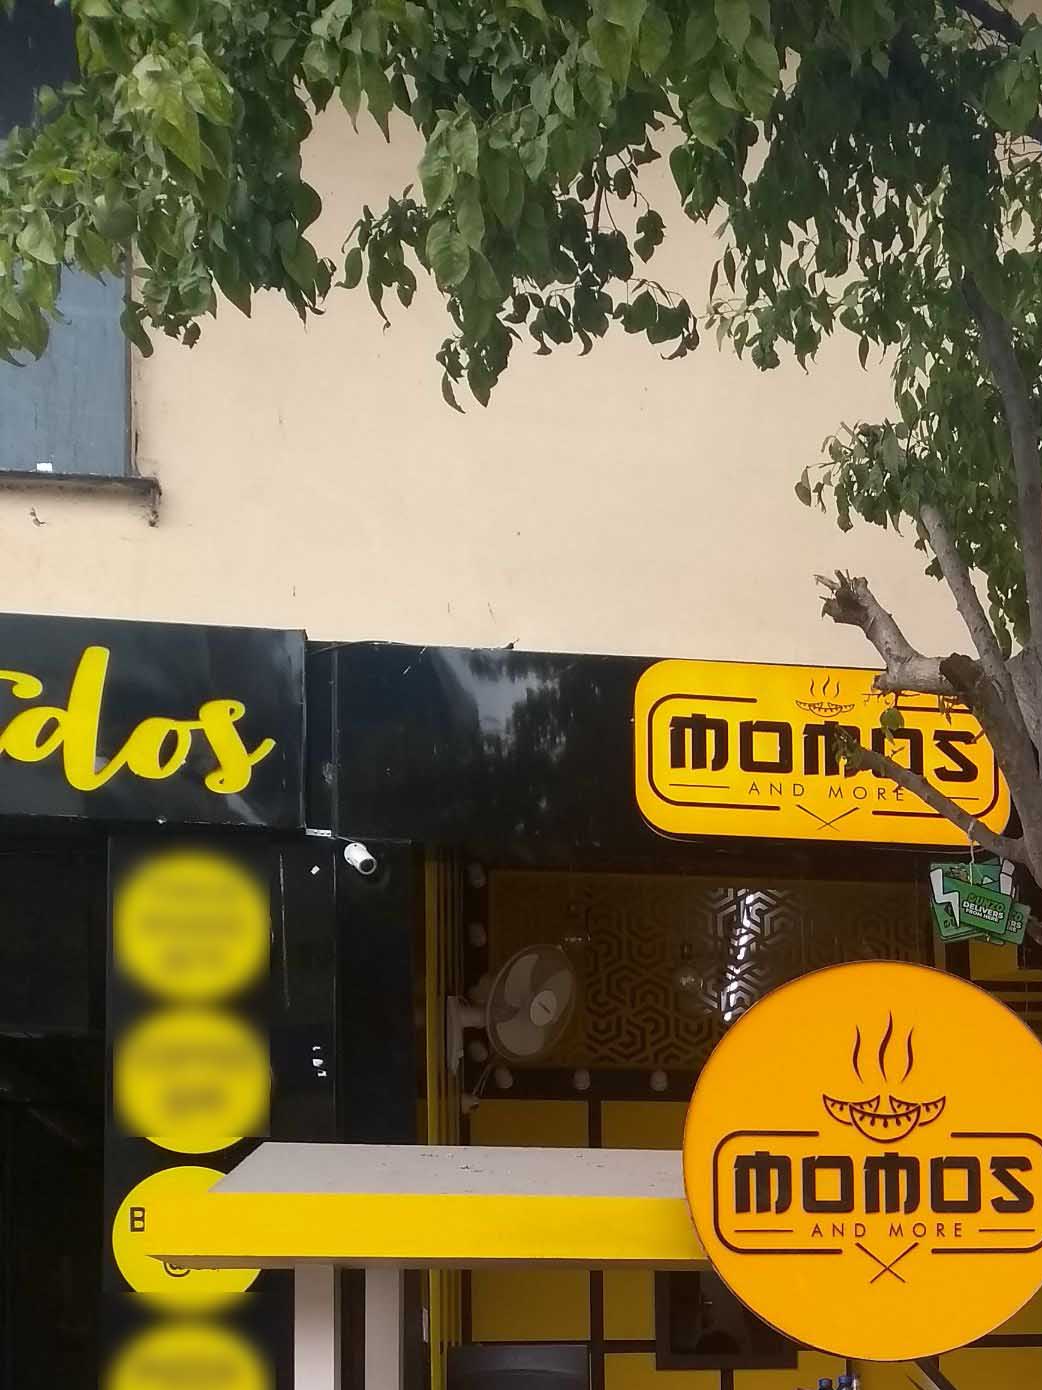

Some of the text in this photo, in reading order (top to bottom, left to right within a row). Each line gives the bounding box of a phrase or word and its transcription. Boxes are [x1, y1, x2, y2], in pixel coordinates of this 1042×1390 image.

[670, 713, 979, 782] MOMOS
[748, 781, 904, 801] AND MORE
[963, 901, 1004, 919] DELIVERS
[734, 1151, 1035, 1214] MOMOS
[811, 1223, 963, 1238] AND MORE
